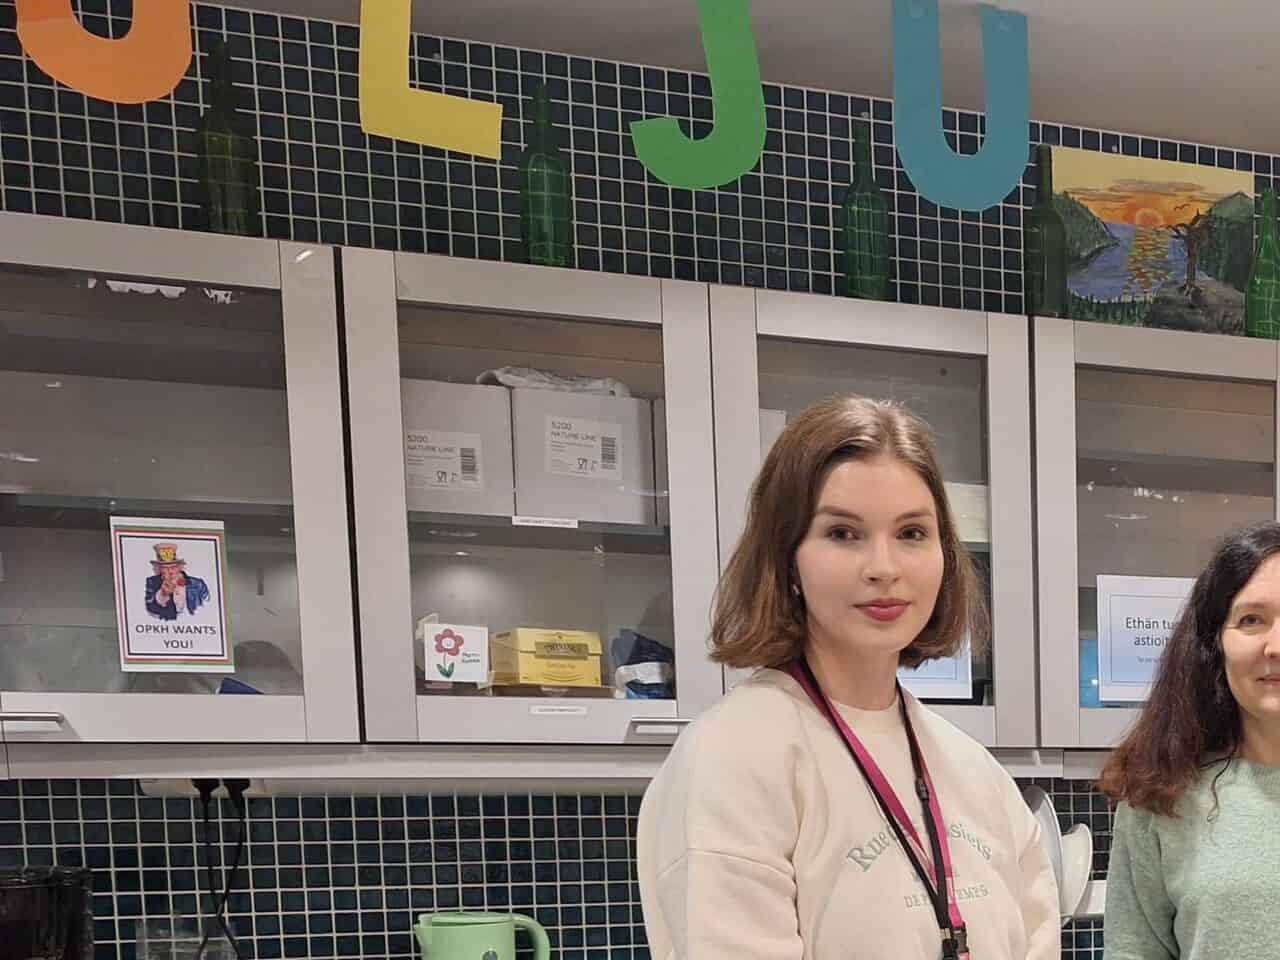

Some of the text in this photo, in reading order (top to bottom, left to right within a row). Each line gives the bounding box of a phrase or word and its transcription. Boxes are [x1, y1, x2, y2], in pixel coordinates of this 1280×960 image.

[1126, 616, 1159, 629] Ethän
[136, 624, 217, 636] OPKH WANTS
[163, 639, 193, 649] YOU!
[846, 829, 891, 873] Rue
